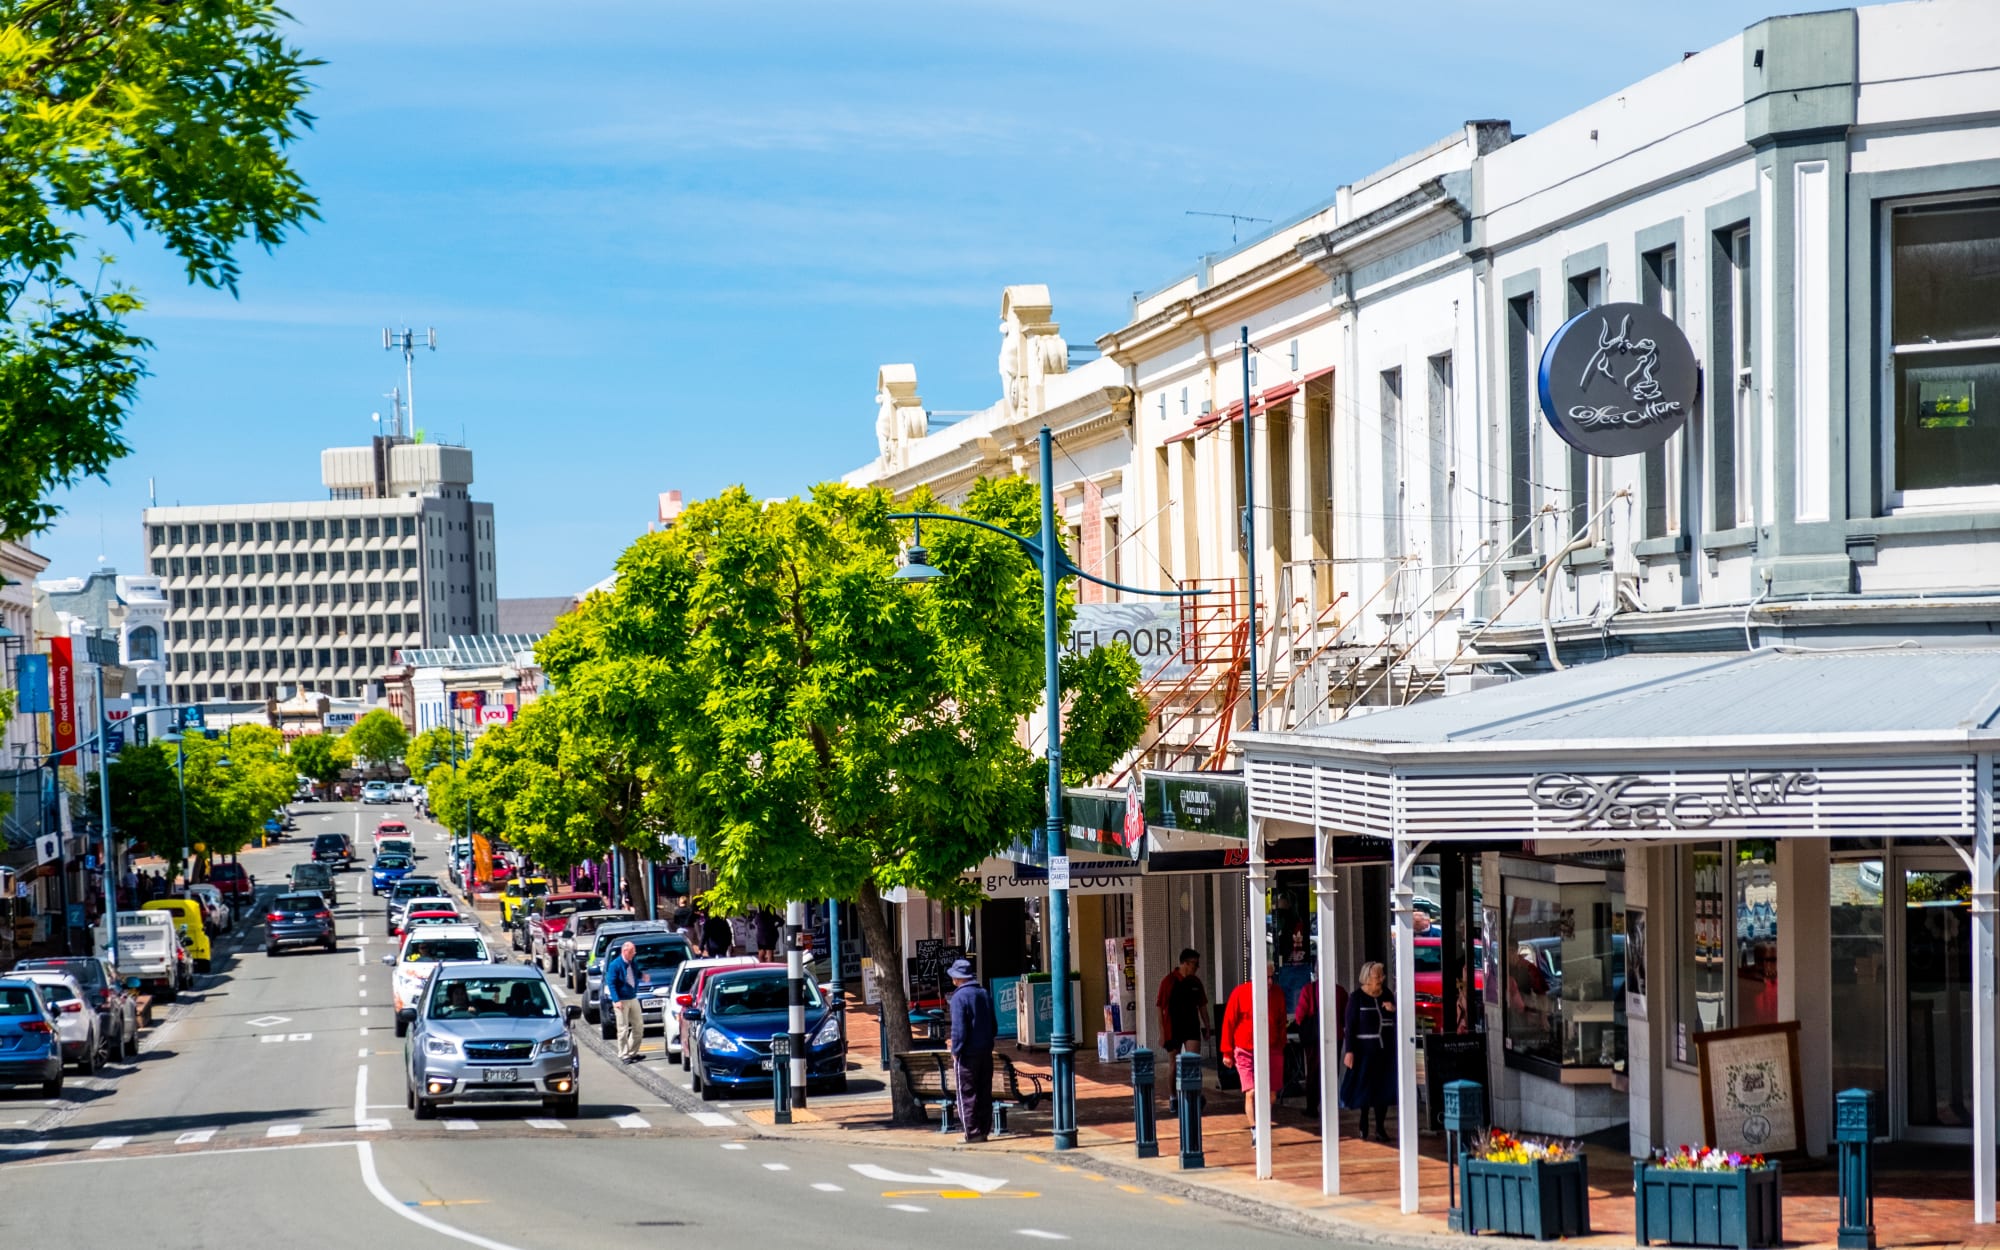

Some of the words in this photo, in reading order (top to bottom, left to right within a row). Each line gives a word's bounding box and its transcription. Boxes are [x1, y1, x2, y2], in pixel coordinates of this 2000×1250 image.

[1568, 405, 1622, 427] Coffee
[1622, 400, 1681, 423] Culture
[59, 665, 68, 701] leeming
[60, 702, 68, 721] noel
[483, 710, 505, 722] you
[1526, 772, 1664, 832] Coffee
[1664, 767, 1823, 827] Culture
